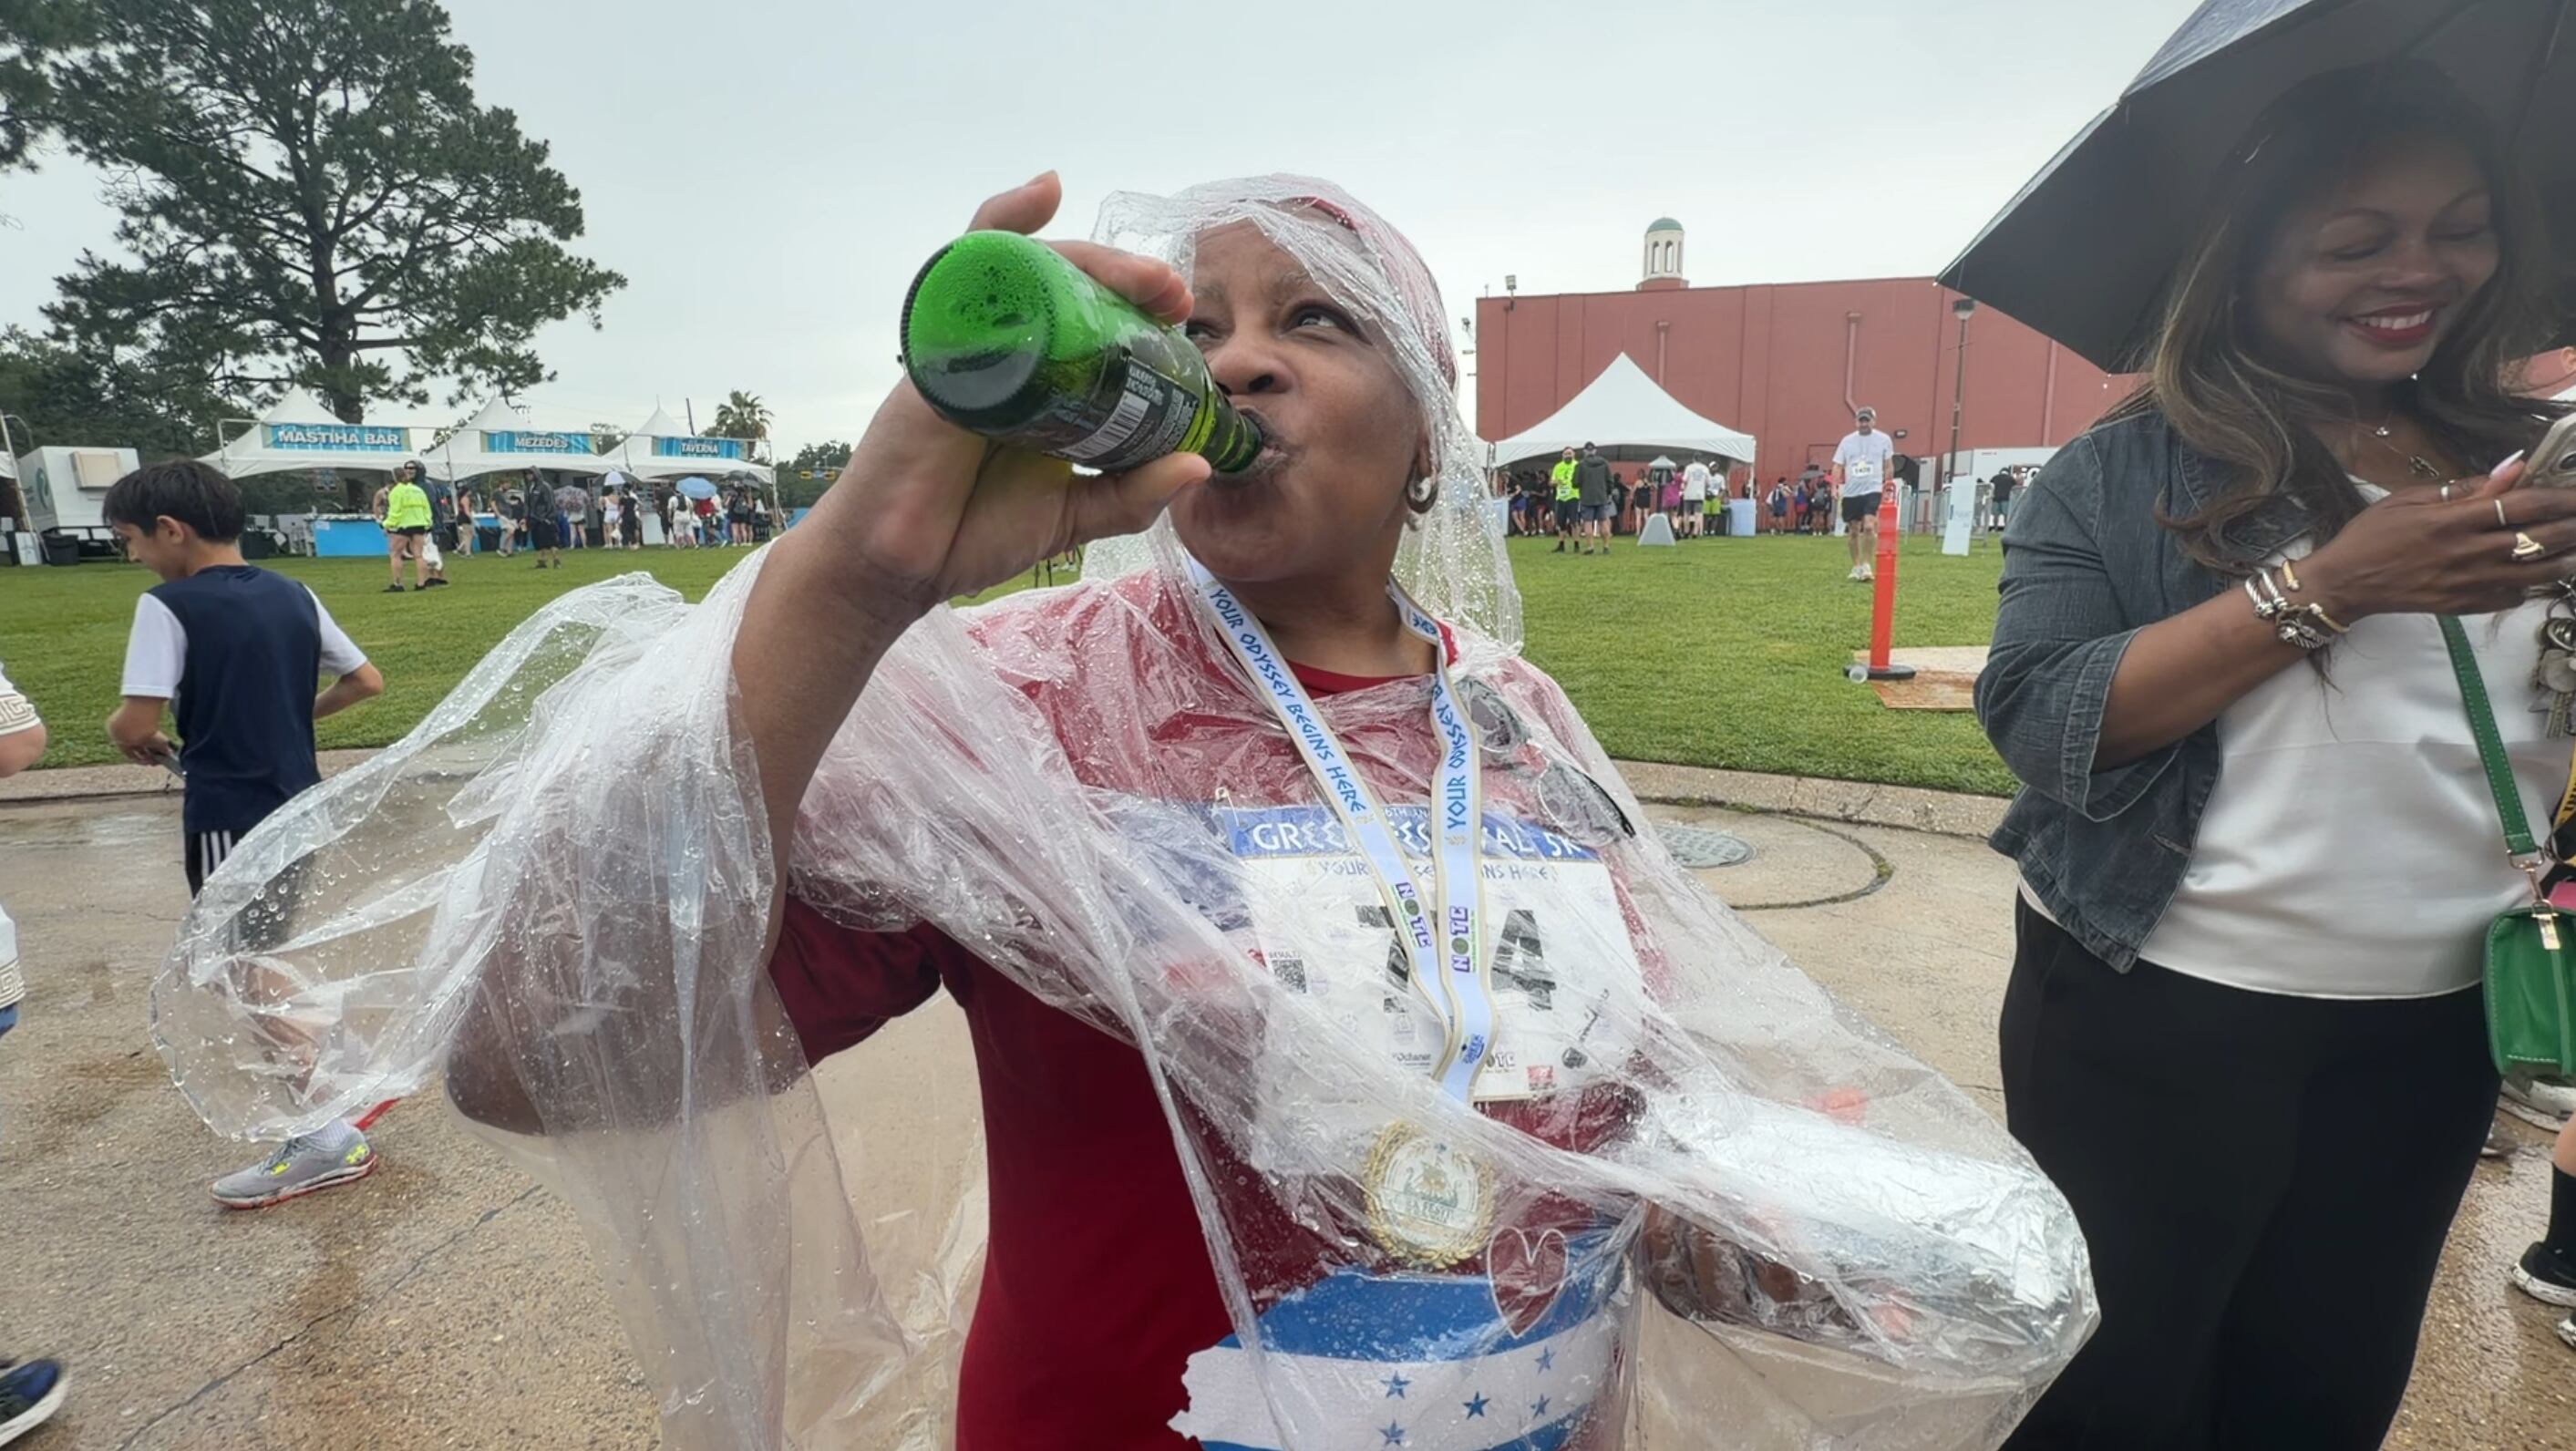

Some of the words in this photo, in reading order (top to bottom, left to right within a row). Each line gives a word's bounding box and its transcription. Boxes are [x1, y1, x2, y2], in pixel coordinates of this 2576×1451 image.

[278, 430, 359, 444] MASTIHA
[364, 433, 400, 445] BAR
[514, 437, 569, 449] MEZEDES
[680, 441, 719, 455] TAVERNA
[1209, 588, 1244, 630] YOUR
[1239, 633, 1295, 699] ODYSSEY
[1285, 704, 1335, 761] BEGINS
[1325, 766, 1367, 812] HERE
[1446, 775, 1467, 830] YOUR
[1543, 831, 1582, 858] 5K
